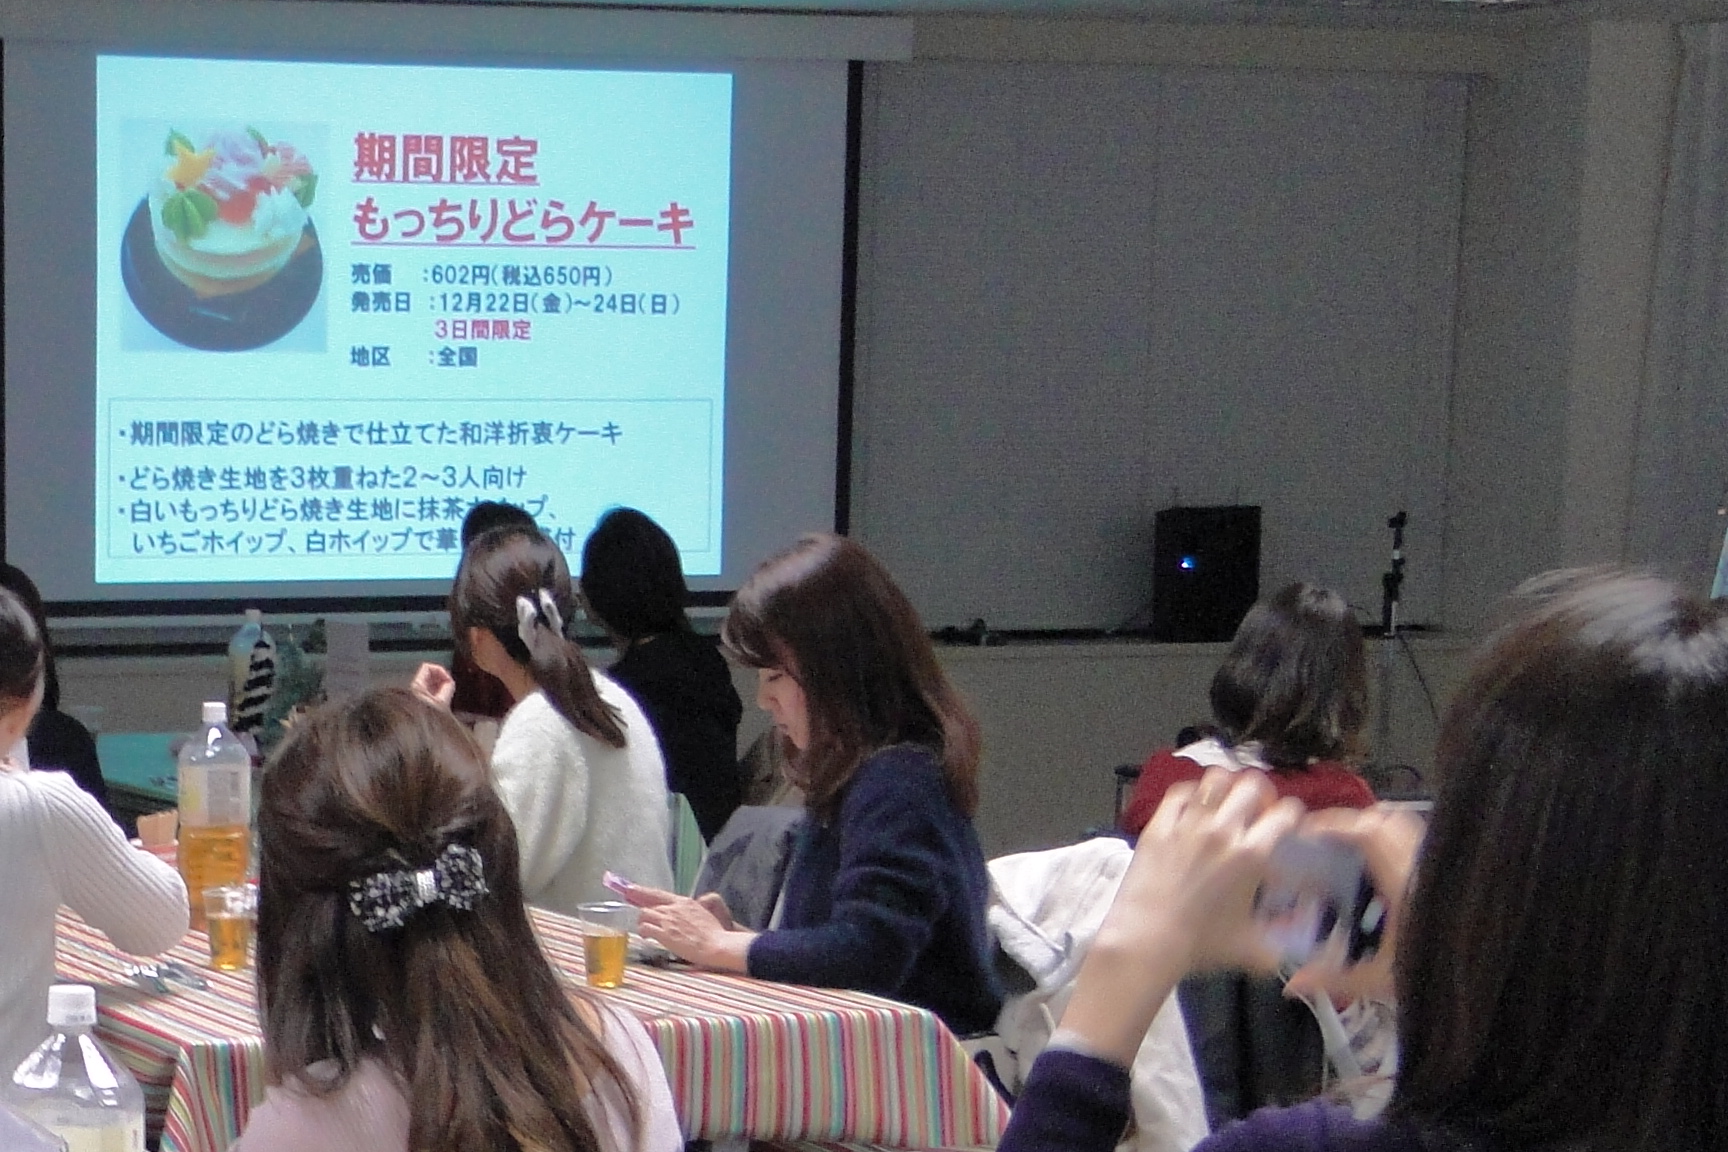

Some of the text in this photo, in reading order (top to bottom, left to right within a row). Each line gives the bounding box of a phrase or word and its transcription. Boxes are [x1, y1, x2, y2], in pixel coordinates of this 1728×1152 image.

[354, 132, 538, 183] 期間限定
[353, 196, 694, 245] もっちりどらケーキ
[351, 263, 392, 286] 売価
[351, 291, 412, 313] 発売日
[433, 318, 532, 341] 3日間限定
[350, 346, 391, 368] 地区
